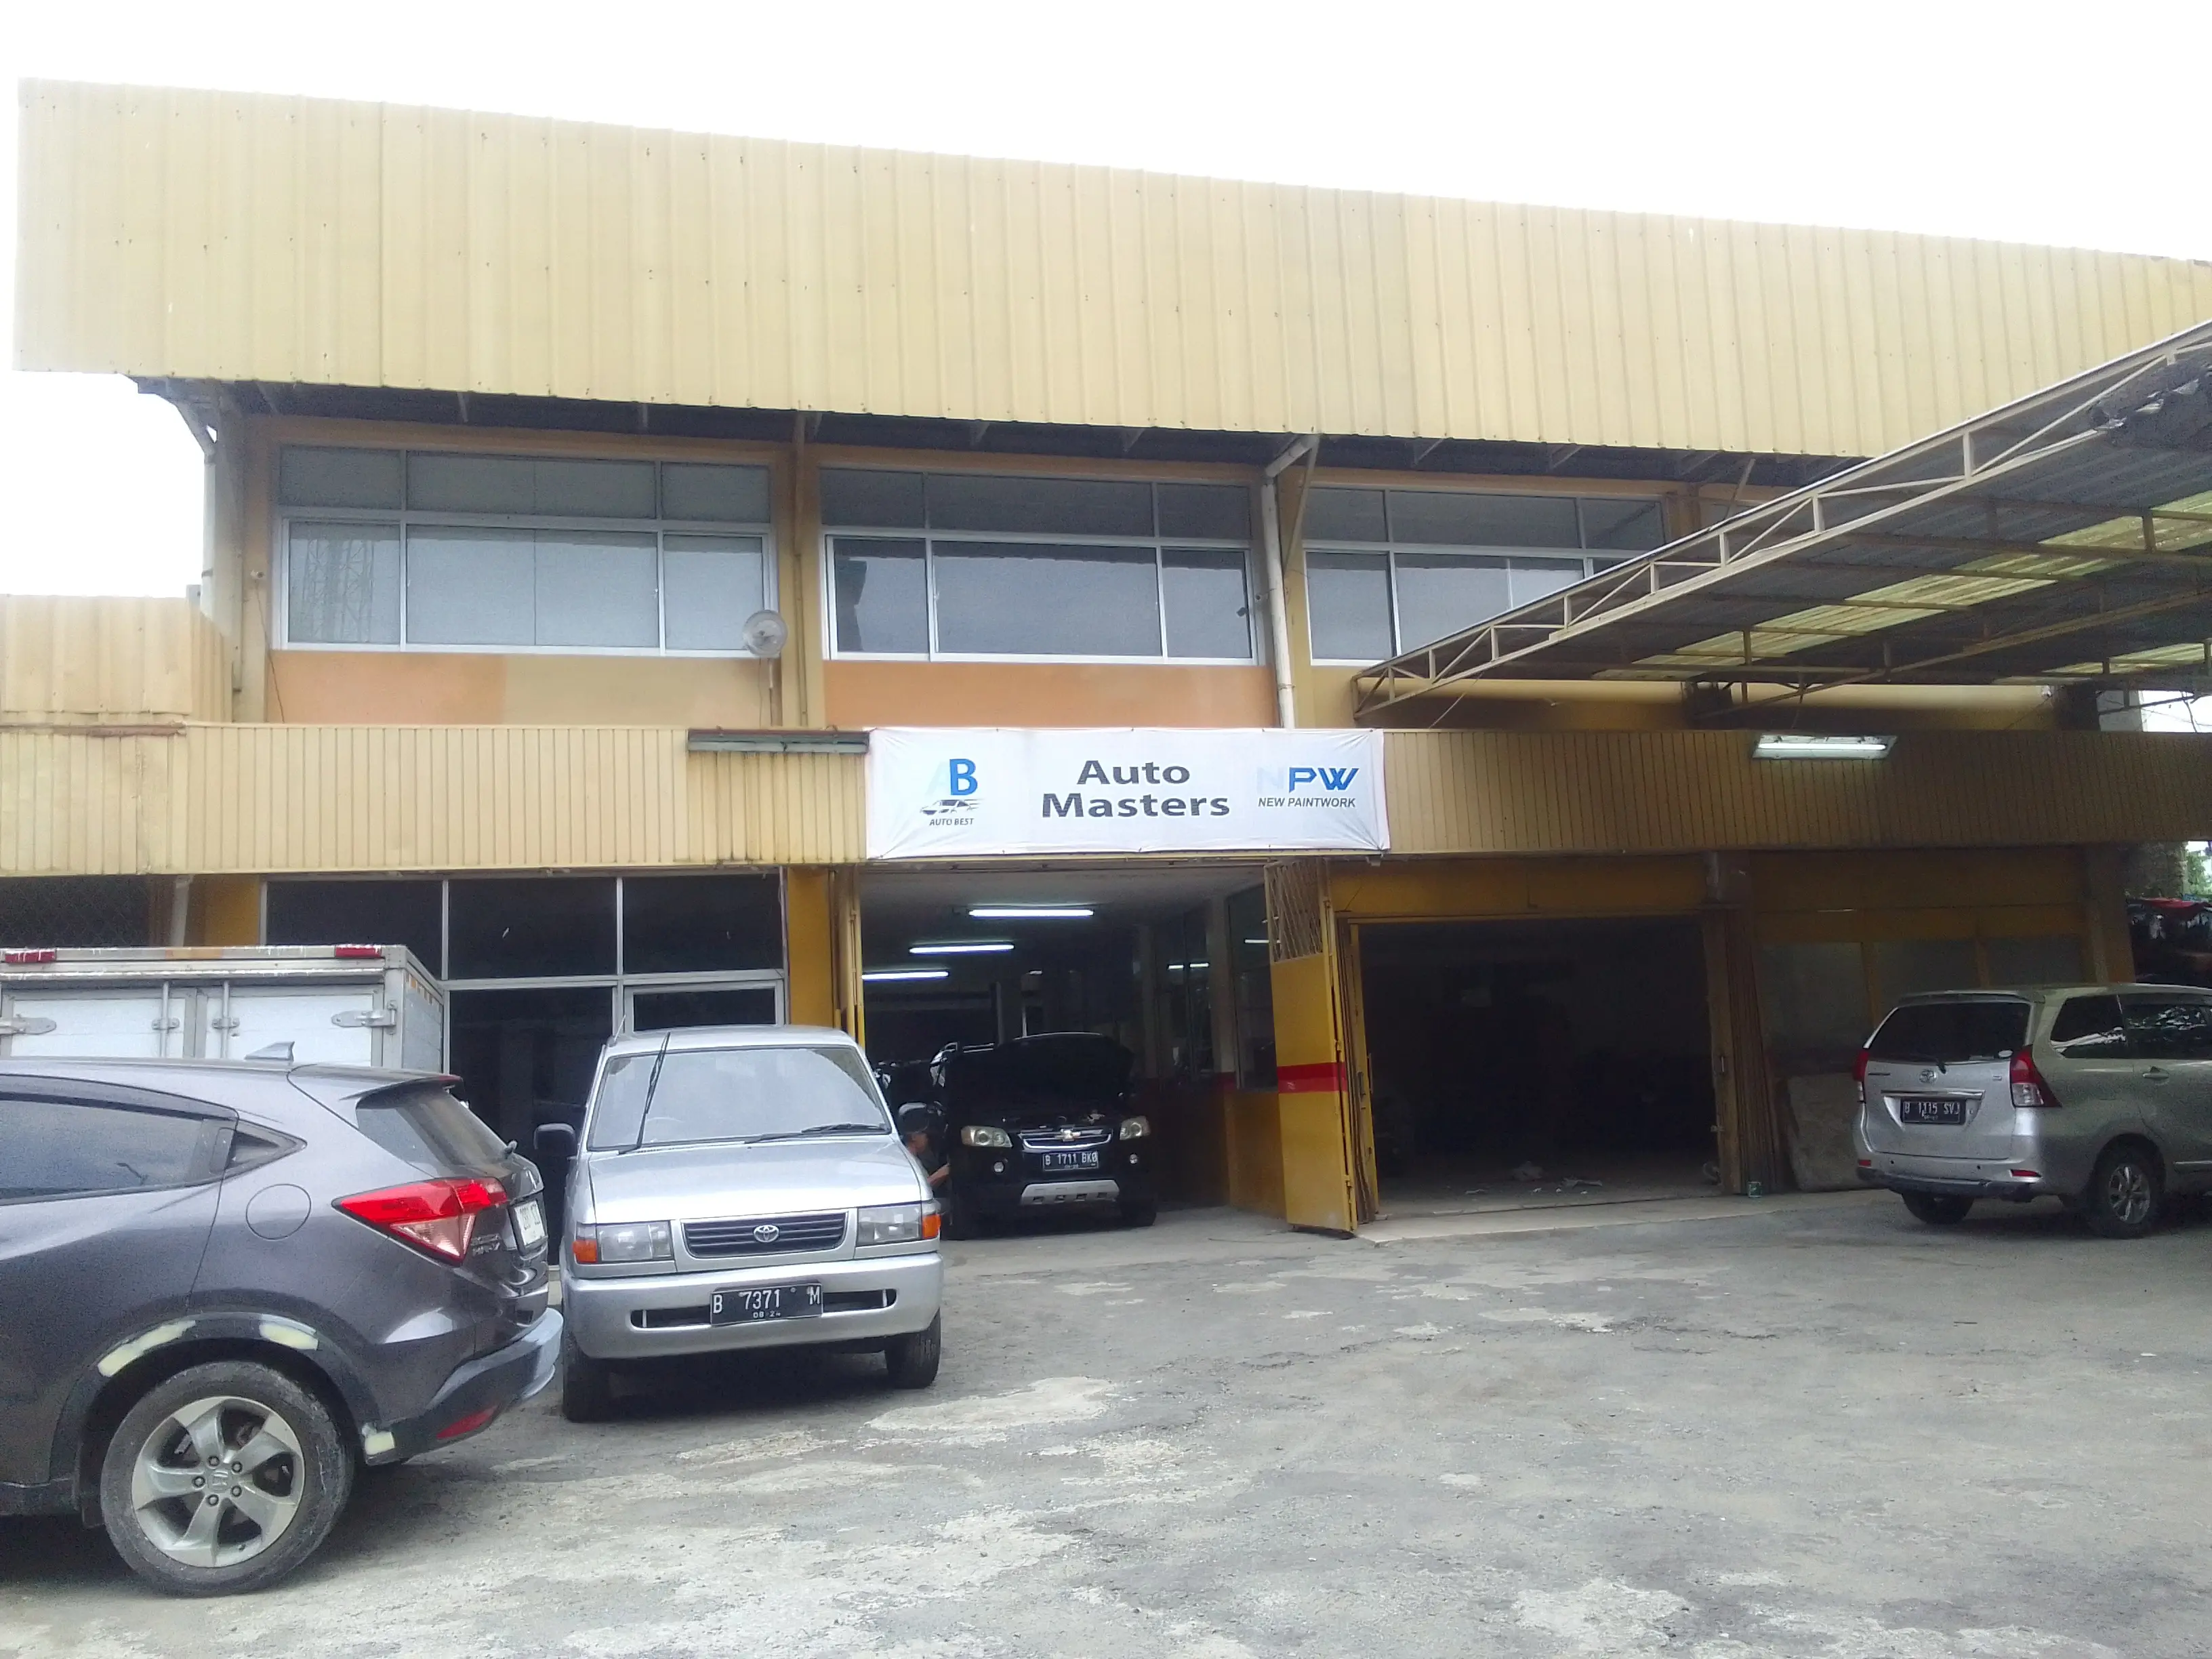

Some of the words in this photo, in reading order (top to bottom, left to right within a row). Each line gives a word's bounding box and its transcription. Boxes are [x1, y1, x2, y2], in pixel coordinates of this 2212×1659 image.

[1076, 760, 1191, 785] Auto
[1042, 792, 1230, 818] Masters
[1258, 797, 1286, 808] NEW
[1288, 797, 1356, 808] PAINTWORK
[929, 817, 953, 826] AUTO
[954, 817, 975, 825] BEST
[1044, 1154, 1051, 1166] B
[713, 1294, 723, 1314] B
[745, 1288, 781, 1310] 7371
